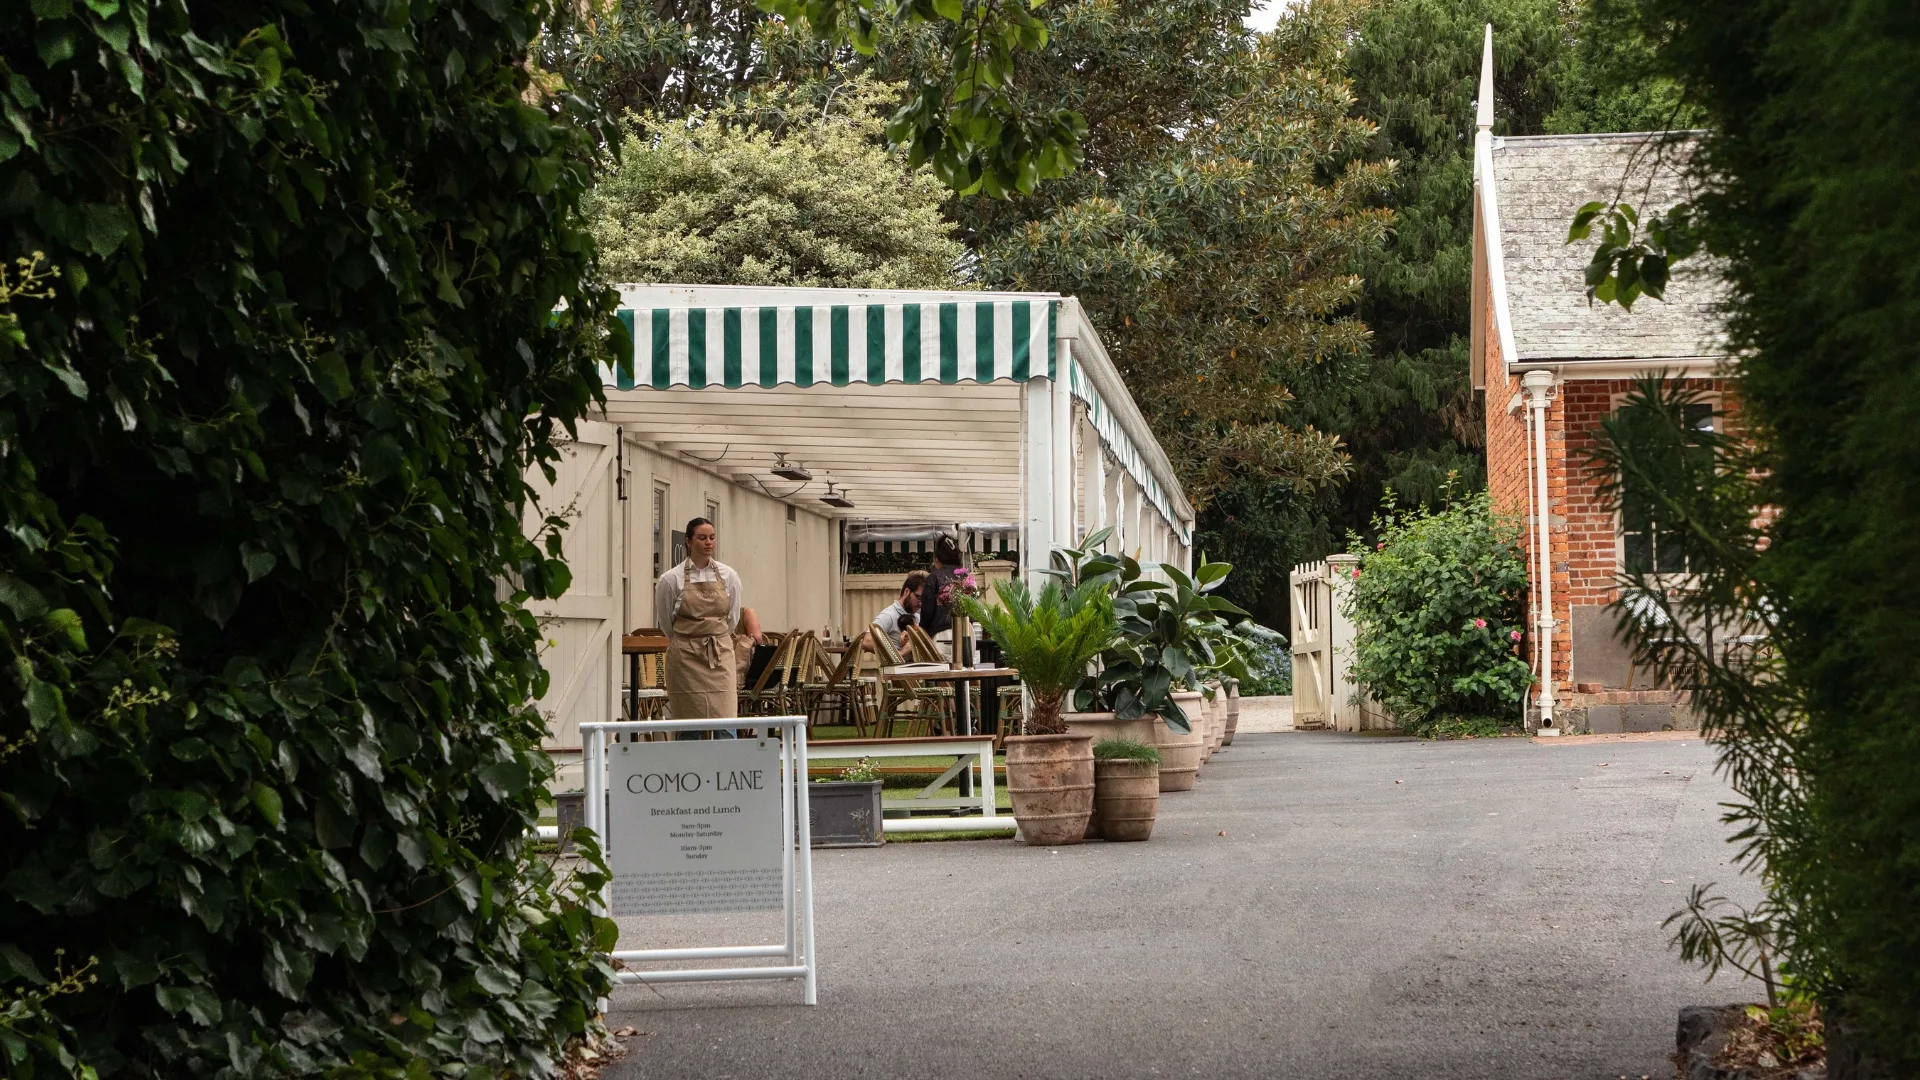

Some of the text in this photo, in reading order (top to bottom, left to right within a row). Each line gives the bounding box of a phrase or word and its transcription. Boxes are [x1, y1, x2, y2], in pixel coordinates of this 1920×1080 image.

[626, 770, 764, 794] COMO LANE
[650, 805, 741, 816] Breakfast and Lunch
[669, 830, 723, 838] Monday-Saturday
[680, 844, 713, 852] 10am-3pm
